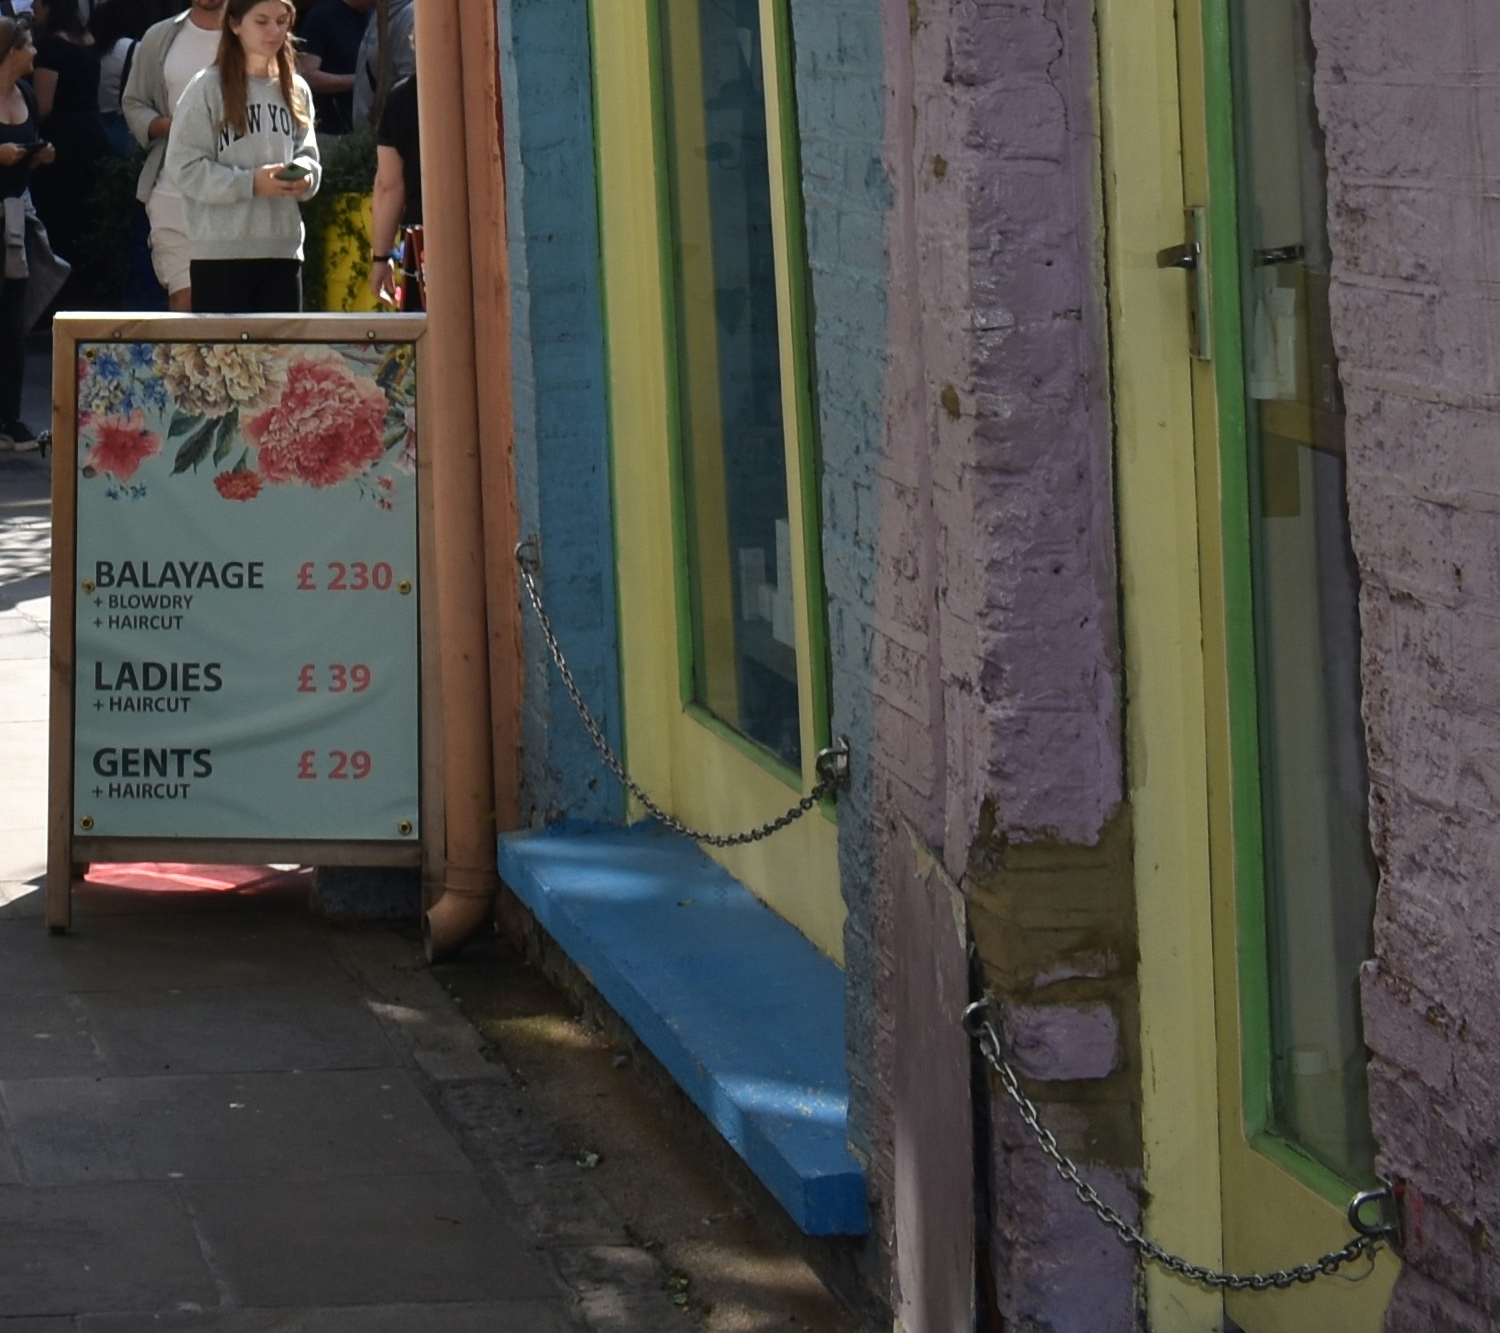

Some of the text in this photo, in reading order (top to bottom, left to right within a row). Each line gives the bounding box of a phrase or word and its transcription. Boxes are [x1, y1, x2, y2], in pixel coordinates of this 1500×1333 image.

[94, 560, 394, 592] BALAYAGE £ 230
[108, 594, 193, 611] BLOWDRY
[108, 614, 184, 631] HAIRCUT
[94, 661, 372, 694] LADIES £ 39
[109, 696, 191, 713] HAIRCUT
[92, 746, 372, 780] GENTS £ 29
[108, 782, 191, 800] HAIRCUT
